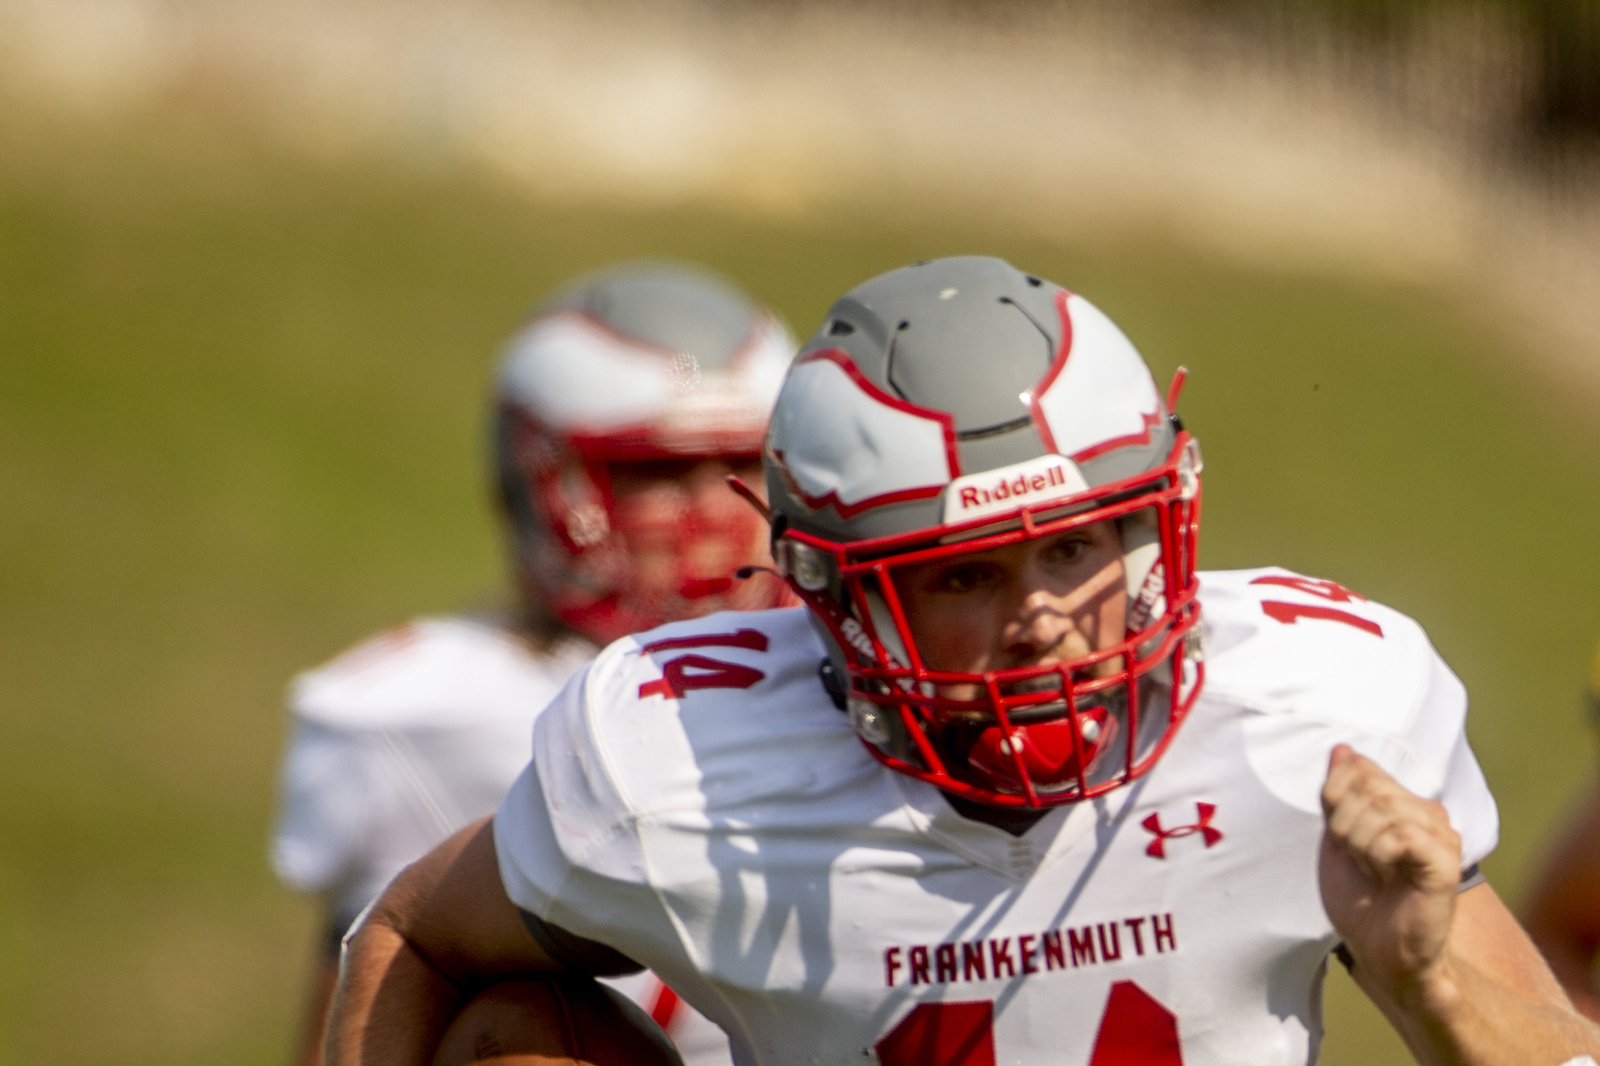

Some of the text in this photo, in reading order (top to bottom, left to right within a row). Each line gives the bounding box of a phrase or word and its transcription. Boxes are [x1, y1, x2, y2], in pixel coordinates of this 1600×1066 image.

[958, 465, 1066, 508] Riddell
[1248, 575, 1385, 639] 14
[639, 628, 769, 700] 14
[883, 912, 1178, 987] FRANKENMUTH
